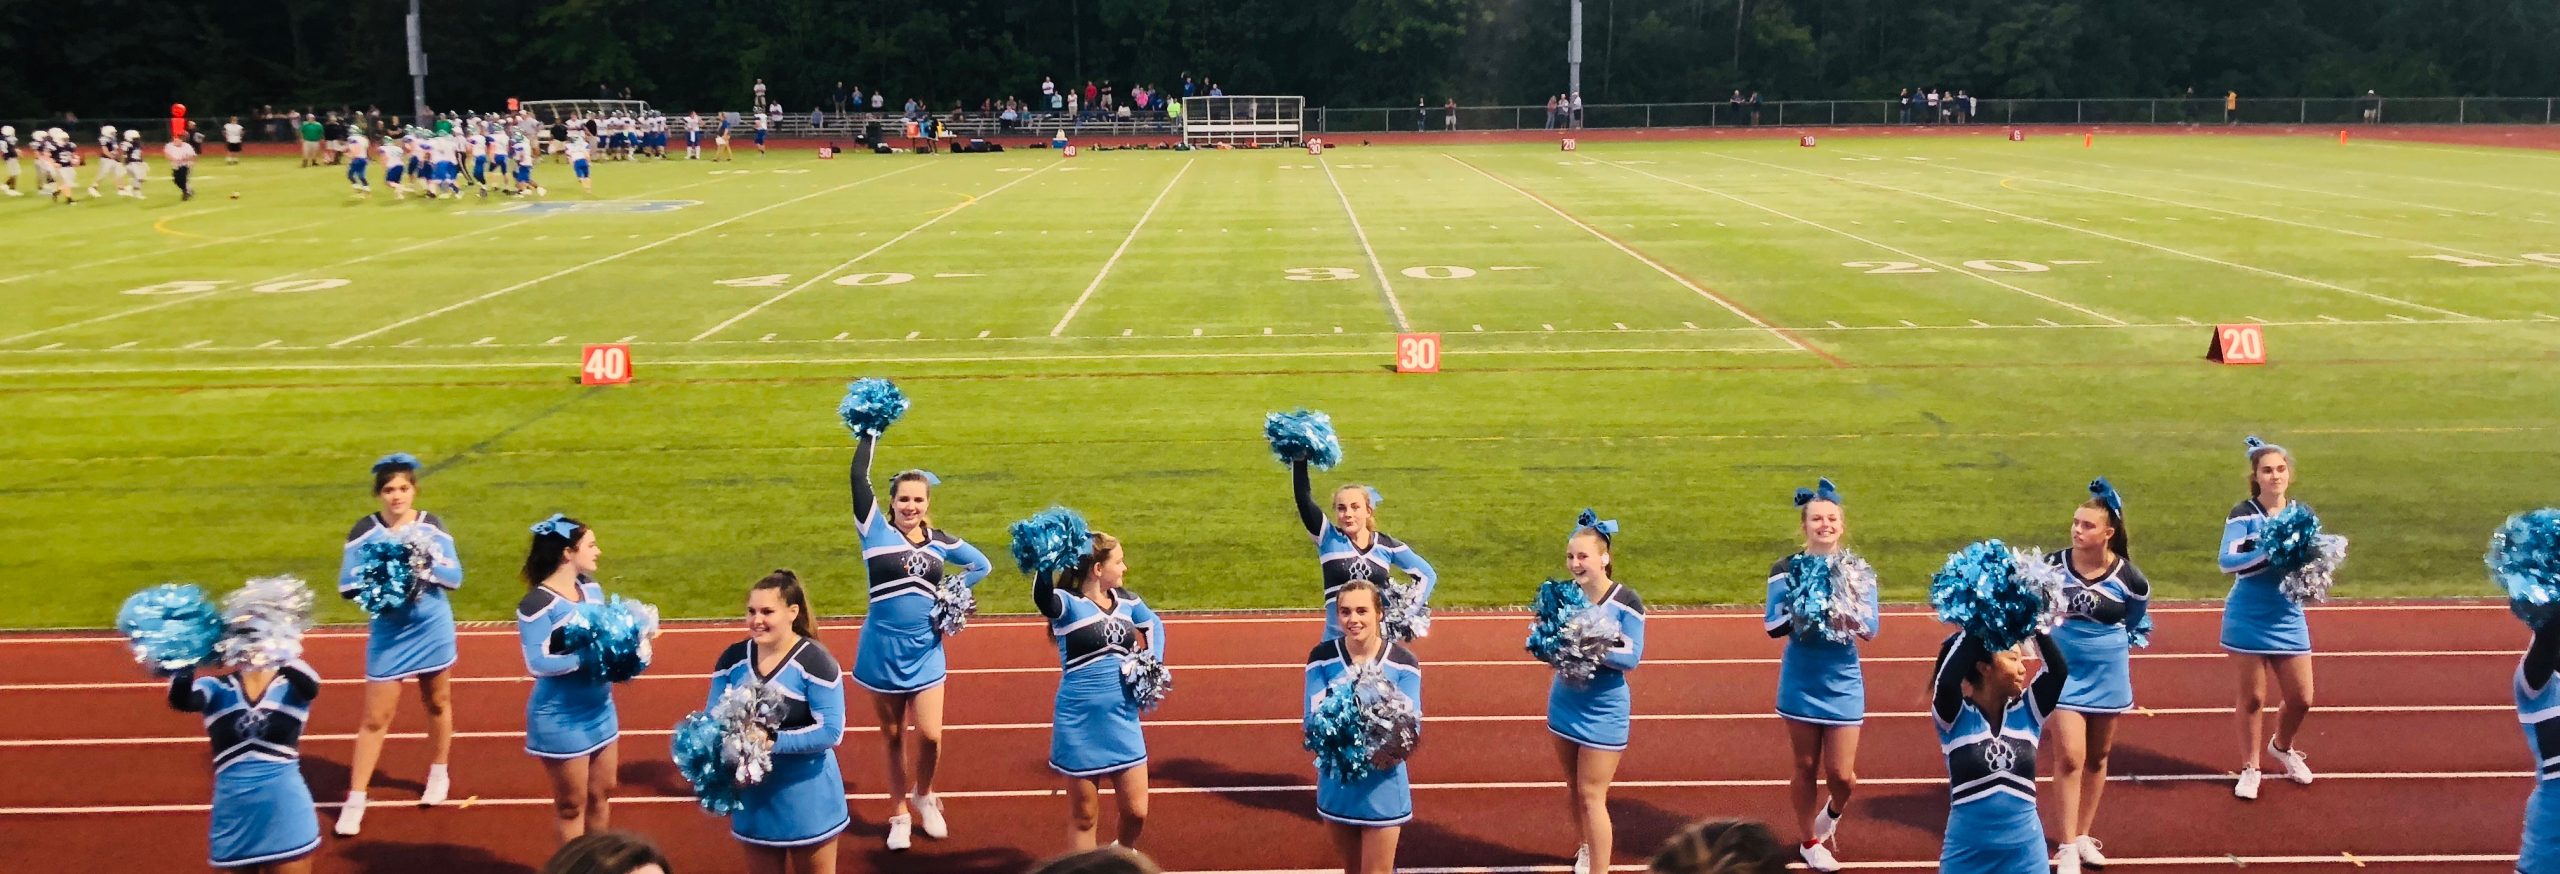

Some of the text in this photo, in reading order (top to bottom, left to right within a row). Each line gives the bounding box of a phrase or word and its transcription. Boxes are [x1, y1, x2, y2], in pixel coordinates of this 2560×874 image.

[1563, 140, 1575, 150] 20
[1804, 136, 1815, 146] 10
[819, 148, 832, 158] 50
[1063, 146, 1075, 156] 40
[1309, 143, 1321, 154] 30
[2223, 328, 2262, 360] 20
[1401, 338, 1436, 369] 30
[584, 347, 625, 380] 40
